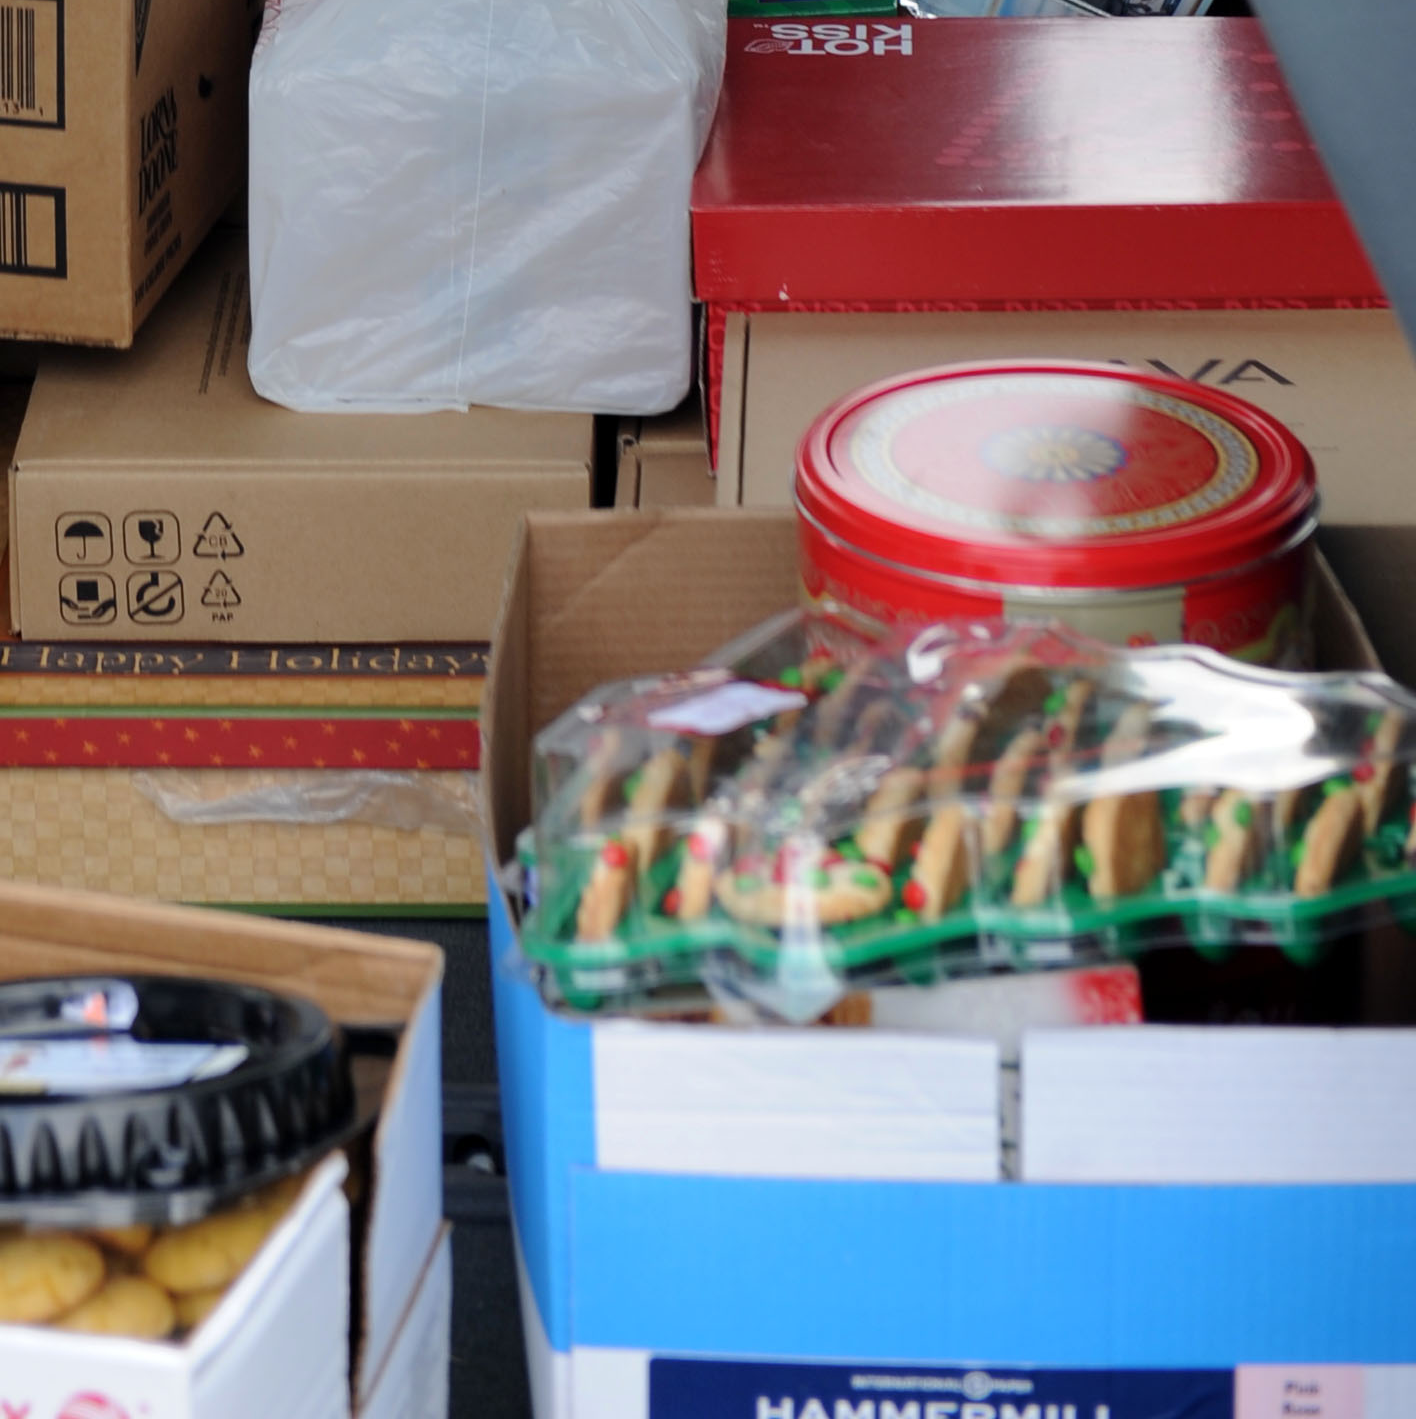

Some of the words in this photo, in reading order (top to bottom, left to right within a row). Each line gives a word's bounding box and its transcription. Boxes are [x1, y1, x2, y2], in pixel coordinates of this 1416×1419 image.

[769, 23, 913, 41] KISS
[787, 40, 913, 56] HOT
[140, 87, 177, 164] LORNA
[139, 129, 178, 216] DOONE
[0, 645, 204, 676] Happy
